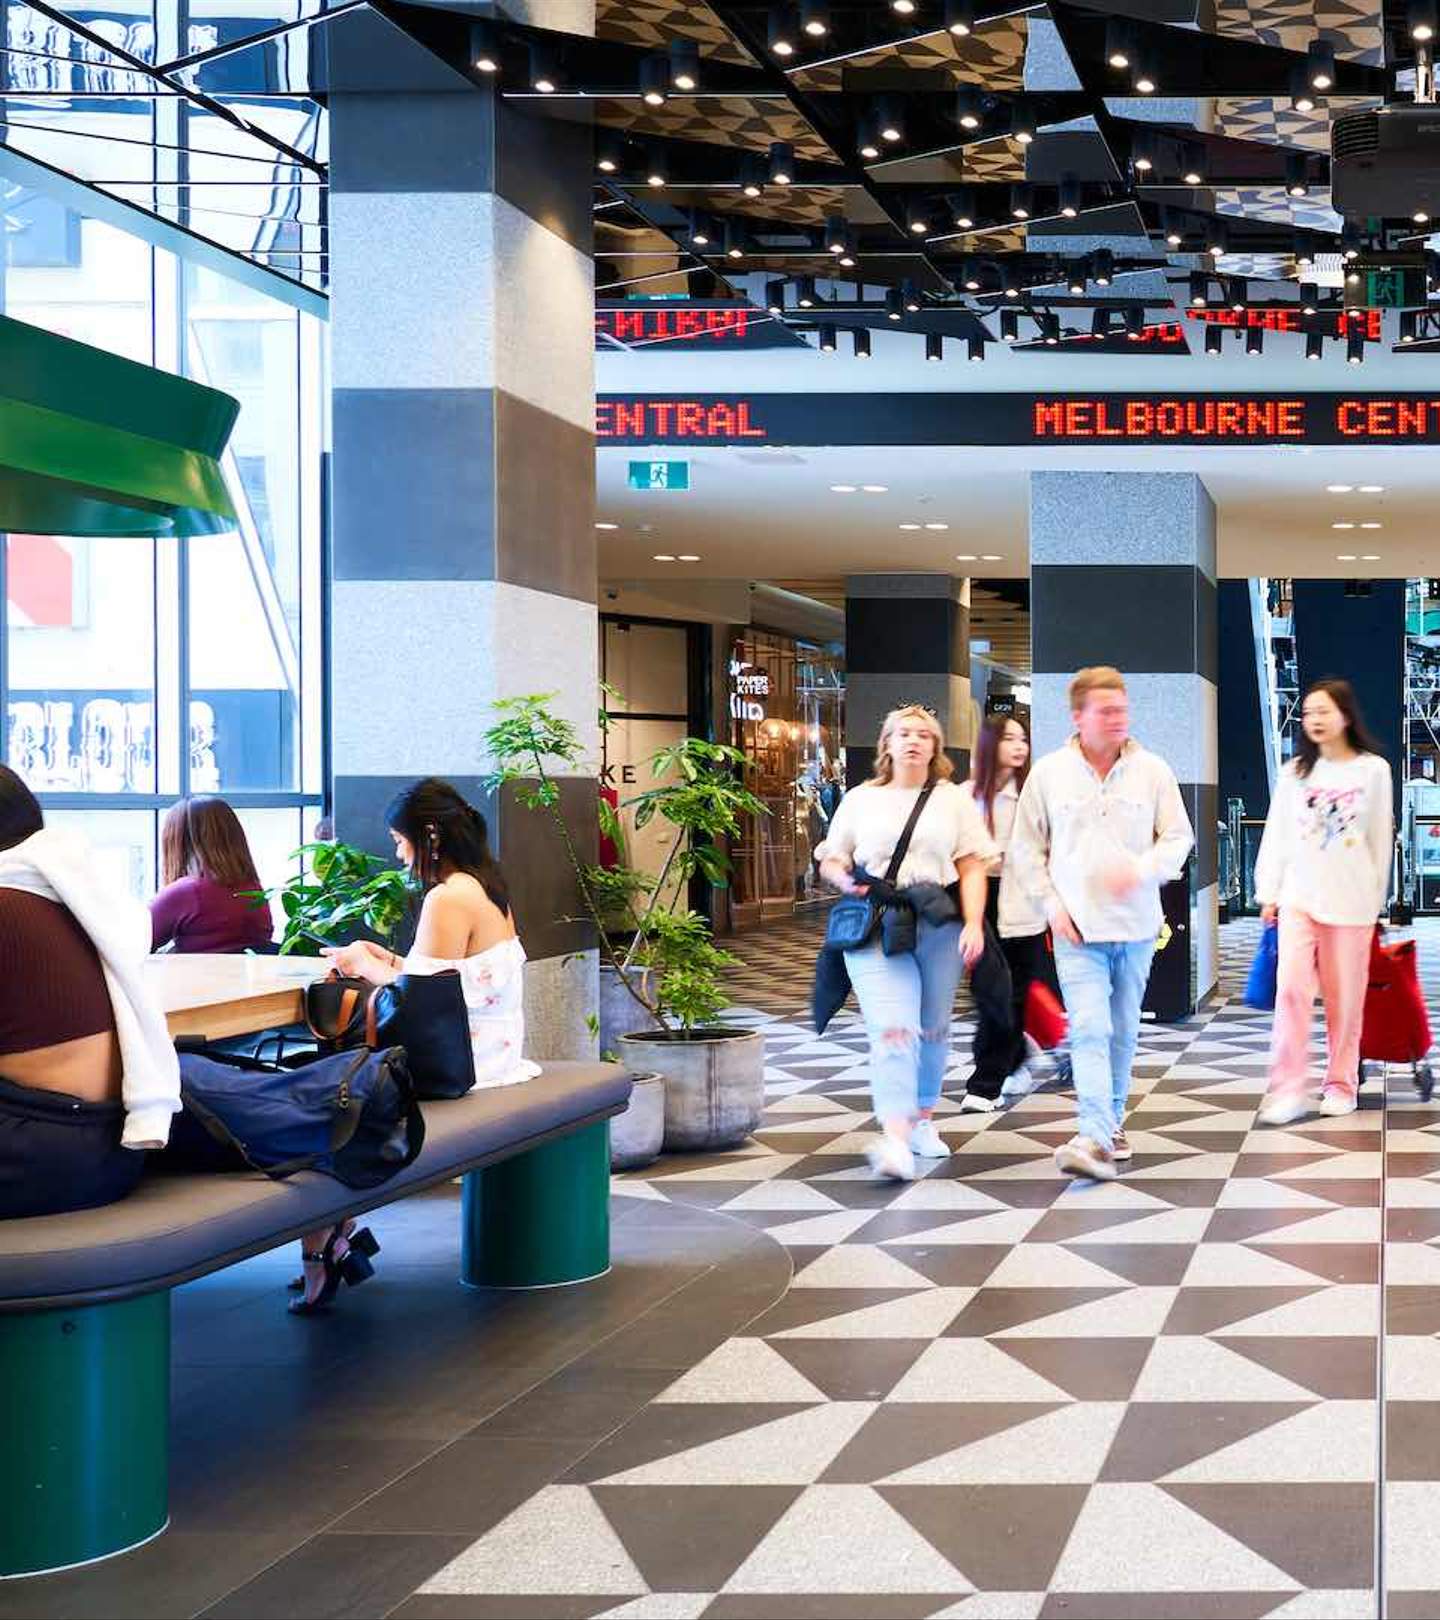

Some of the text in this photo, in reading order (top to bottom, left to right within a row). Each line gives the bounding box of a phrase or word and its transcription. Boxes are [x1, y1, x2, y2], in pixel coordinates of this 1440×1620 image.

[1035, 401, 1305, 436] MELBOURNE
[737, 676, 768, 685] PAPER
[737, 685, 768, 694] KITES
